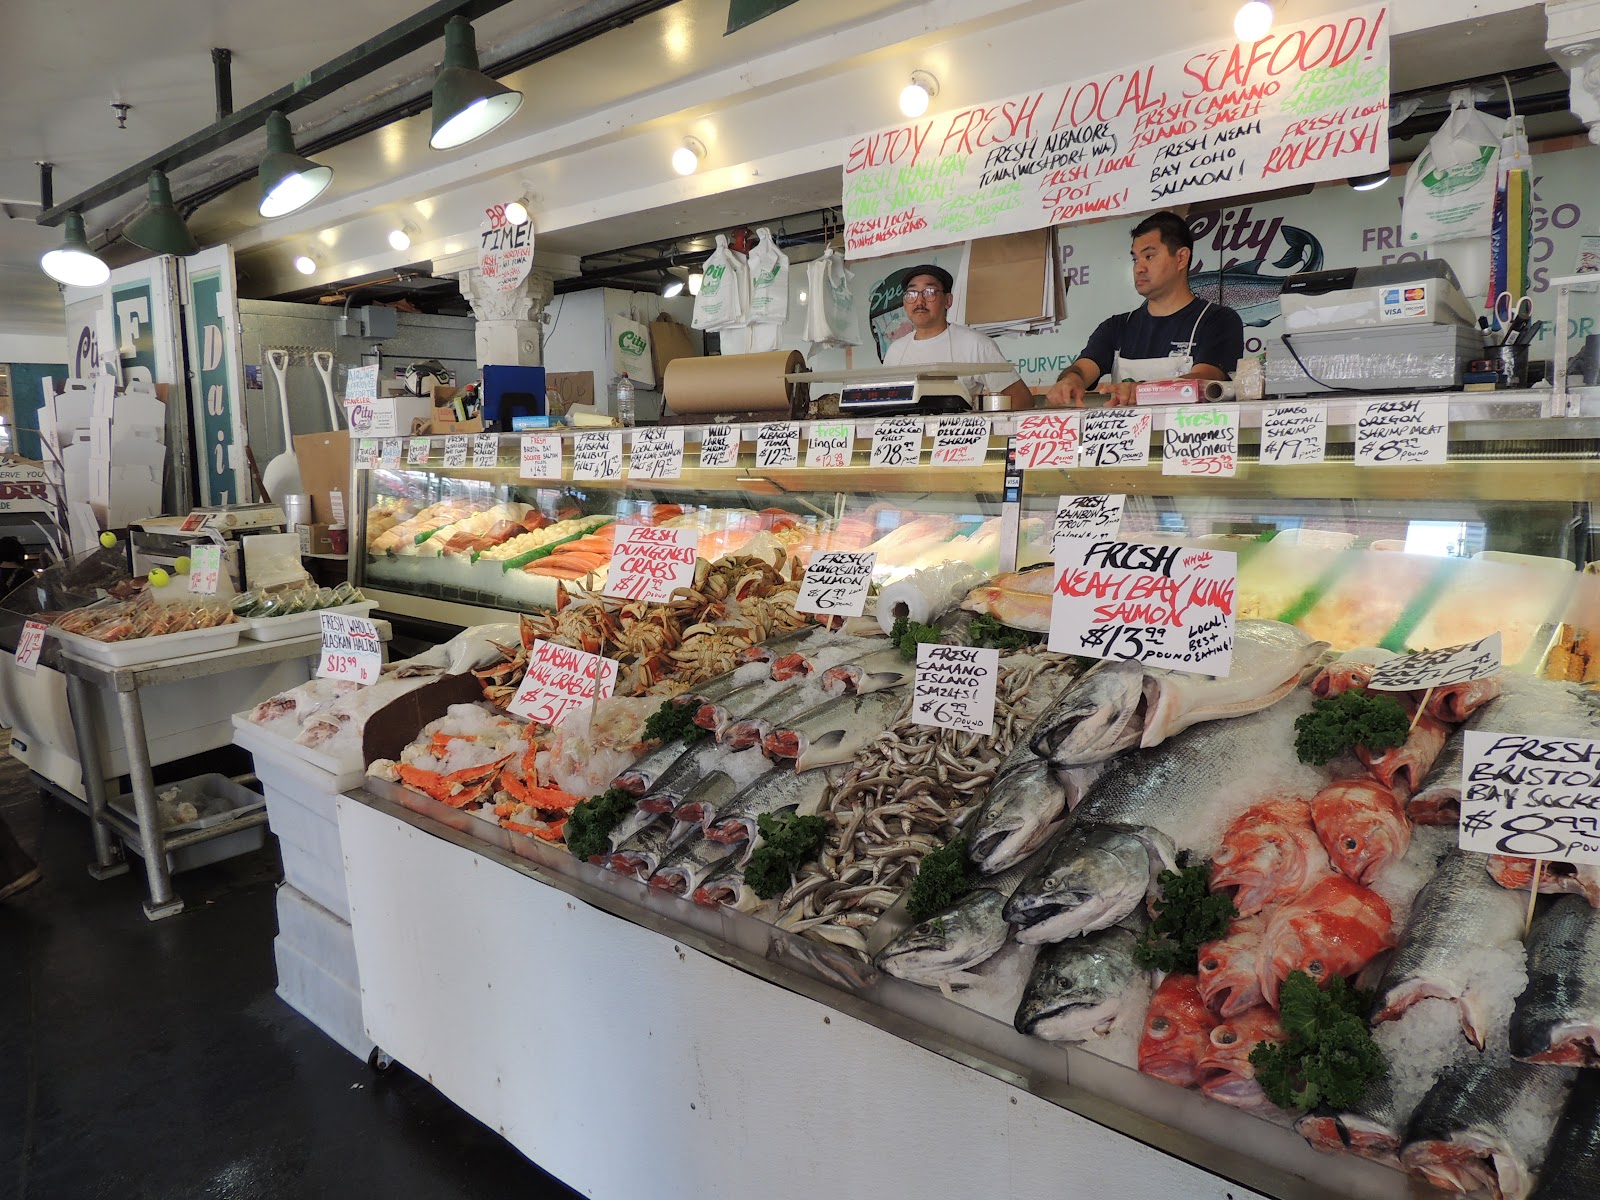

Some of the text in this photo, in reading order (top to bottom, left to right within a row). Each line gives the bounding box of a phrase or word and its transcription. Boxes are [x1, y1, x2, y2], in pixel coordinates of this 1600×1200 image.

[846, 121, 933, 173] ENJOY
[1051, 66, 1167, 132] LOCAL,
[1183, 8, 1386, 99] SEAFOOD!
[1133, 80, 1280, 133] FRESH CAMANO
[1128, 100, 1267, 152] ISLAND SMELT
[1280, 98, 1388, 144] FRESH LOCAL
[984, 122, 1115, 168] FRESH ALBACORE
[1153, 119, 1261, 164] FRESH NEAH
[1262, 115, 1381, 179] ROCKFISH
[1039, 153, 1140, 191] FRESH LOCAL
[1150, 147, 1237, 184] BAY COHO
[846, 167, 891, 198] FRESH
[938, 154, 969, 177] BAY
[1151, 159, 1246, 202] SALMON!
[1042, 180, 1102, 209] SPOT
[1050, 187, 1128, 224] PRAWNS!
[846, 207, 921, 238] FRESH LOCAL
[482, 220, 532, 250] TIME!
[619, 331, 646, 355] City
[1268, 407, 1307, 417] JUMBO
[1366, 400, 1421, 415] FRESH
[352, 405, 373, 427] City
[880, 419, 916, 427] FRESH
[1020, 415, 1073, 431] BAY
[1174, 408, 1228, 428] fresh
[1265, 414, 1323, 427] COCKTAIL
[1358, 412, 1425, 427] OREGON
[639, 427, 667, 440] FRESH
[709, 425, 731, 437] WILD
[761, 423, 791, 431] FRESH
[816, 424, 848, 437] fresh
[875, 428, 906, 436] BLACK
[1085, 420, 1128, 431] WHITE
[1267, 425, 1315, 438] SHRIMP
[1358, 425, 1445, 440] SHRIMP MEAT
[531, 436, 546, 444] FRESH
[580, 432, 611, 441] FRESH
[703, 437, 727, 446] LARGE
[758, 431, 798, 440] ALBACORE
[938, 436, 981, 447] SHRIMP
[1016, 428, 1077, 441] SCALLOPS
[1083, 431, 1130, 443] SHRIMP
[1166, 427, 1234, 444] Dungeness
[575, 442, 610, 451] ALASKAN
[631, 444, 651, 454] LOCAL
[809, 437, 848, 455] Ling Cod
[575, 451, 610, 459] HALIBUT
[574, 460, 595, 471] FILLET
[1068, 495, 1109, 510] FRESH
[1056, 509, 1100, 519] RAINBOW
[1059, 520, 1091, 529] TROUT
[628, 528, 678, 543] FRESH
[613, 543, 696, 565] DUNGENESS
[1083, 541, 1213, 577] FRESH WHOLE
[620, 557, 679, 580] CRABS
[807, 575, 866, 585] SALMON
[1053, 567, 1235, 615] NEAH BAY KING
[1092, 603, 1186, 627] SALMON
[321, 614, 374, 635] FRESH WHOLE
[1188, 614, 1228, 638] LOCAL!
[322, 633, 380, 654] ALASKAN HALIBUT
[1189, 633, 1218, 651] BEST
[1195, 637, 1233, 662] EATING!
[535, 641, 585, 673] ALASKAN
[929, 647, 979, 663] FRESH
[1141, 650, 1191, 661] POUND
[361, 668, 367, 679] lb
[916, 662, 987, 676] CAMANO
[526, 661, 611, 700] KING CRAB LES
[917, 672, 979, 687] ISLAND
[916, 685, 978, 703] SMELTS!
[953, 717, 984, 726] POUND
[1468, 762, 1600, 787] BRISTOL
[1461, 784, 1600, 810] BAY SOCKE
[1565, 841, 1600, 857] POU
